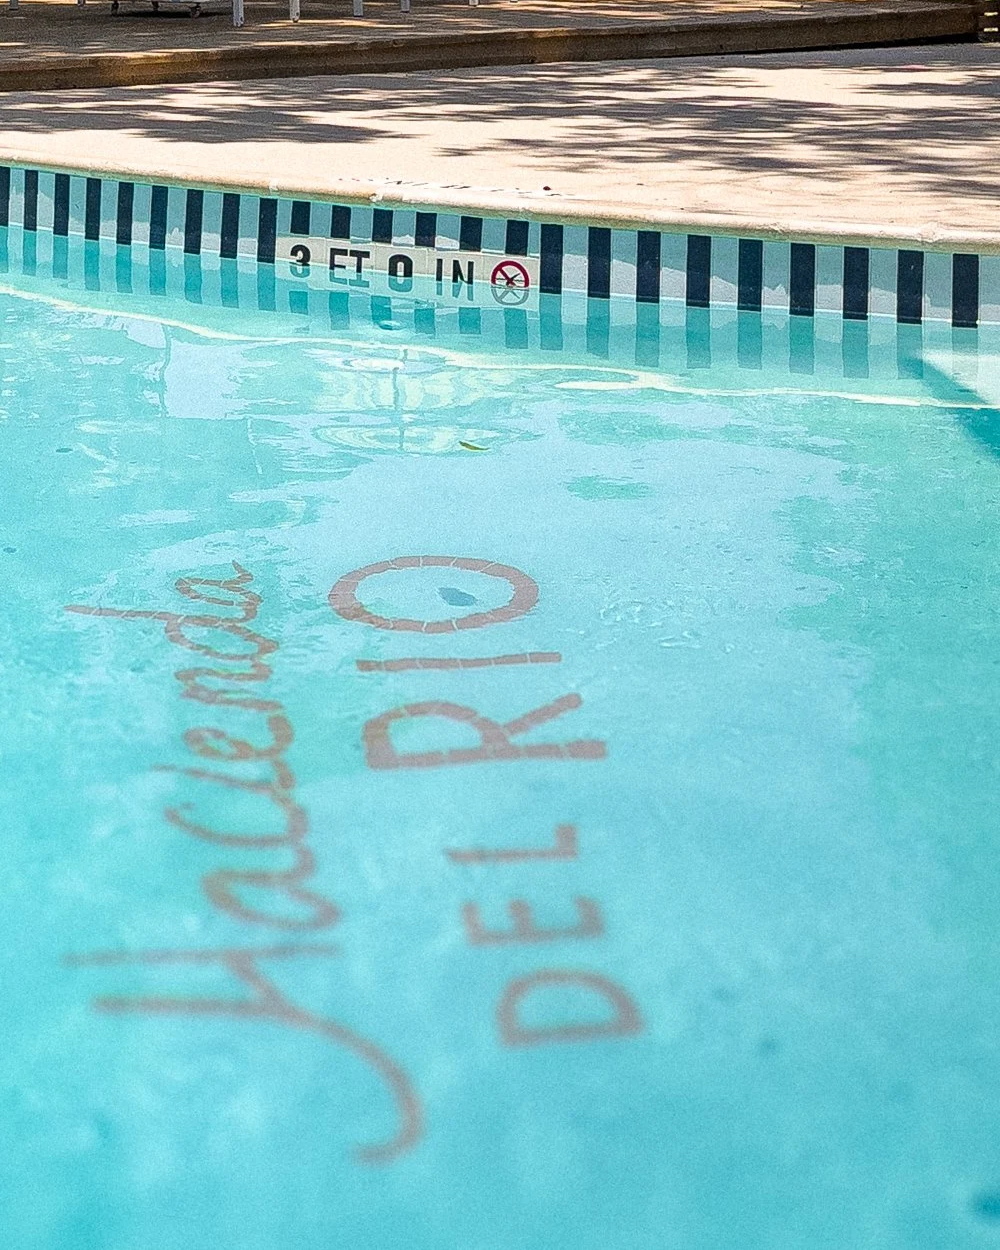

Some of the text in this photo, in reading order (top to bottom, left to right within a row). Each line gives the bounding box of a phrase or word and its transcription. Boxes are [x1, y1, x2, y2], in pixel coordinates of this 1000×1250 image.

[290, 244, 311, 266] 3
[329, 247, 370, 273] FT
[435, 258, 475, 285] IN
[63, 561, 427, 1165] Hacienda
[328, 555, 645, 1048] DEL RIO
